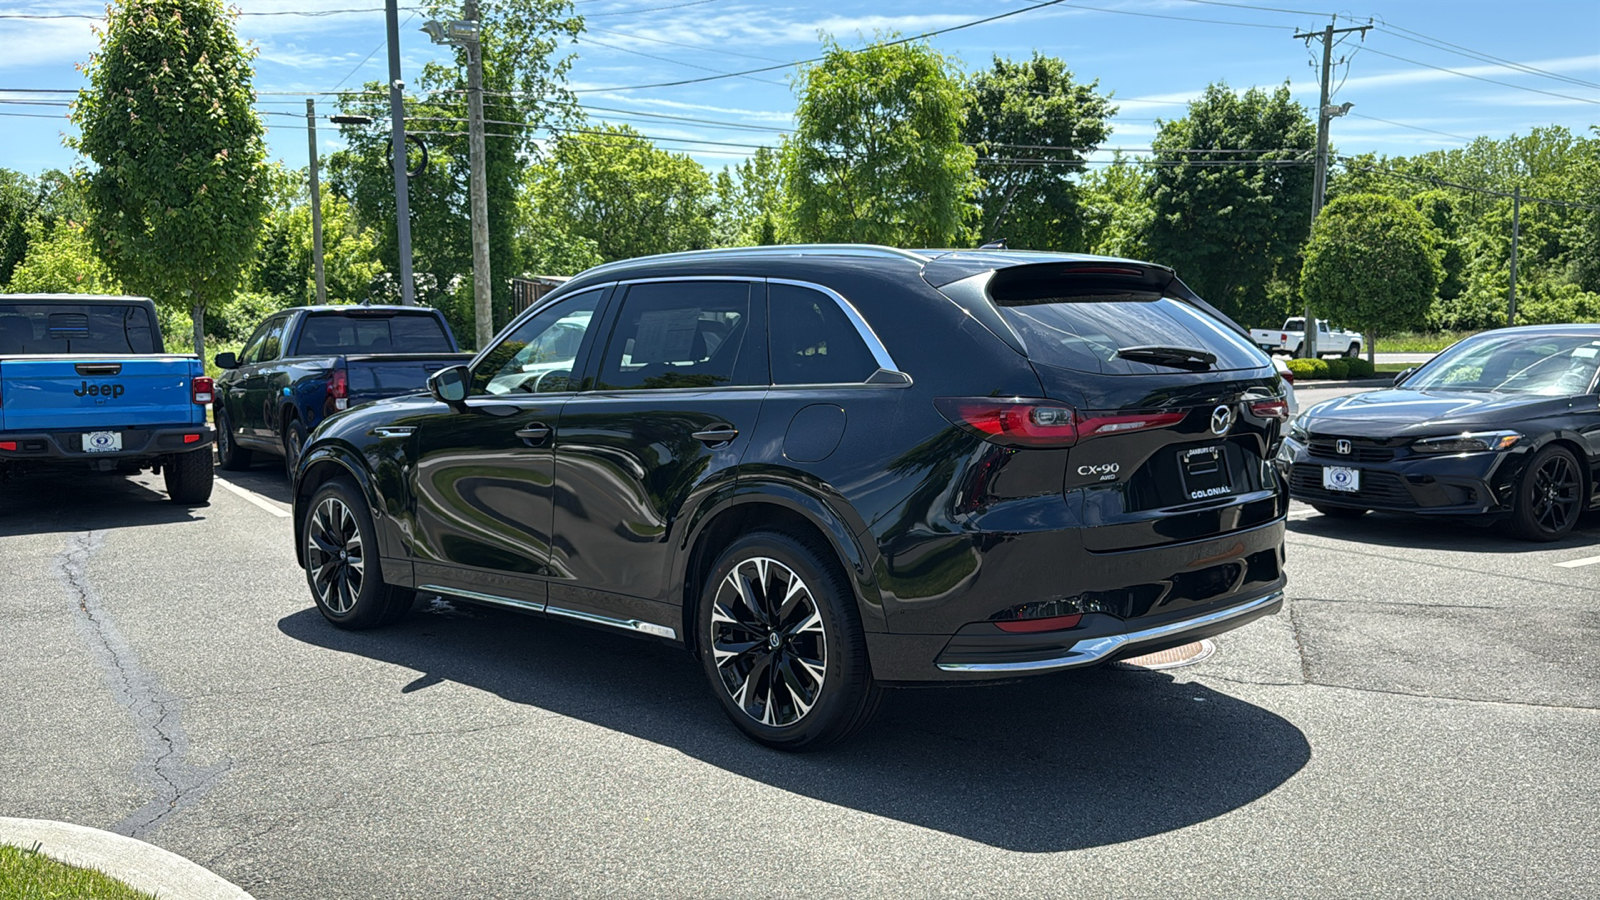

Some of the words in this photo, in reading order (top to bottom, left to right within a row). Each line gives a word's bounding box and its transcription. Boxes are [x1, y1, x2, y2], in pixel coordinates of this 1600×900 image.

[74, 381, 124, 398] Jeep
[1077, 463, 1119, 475] CX-90
[1191, 486, 1231, 498] COLONIAL
